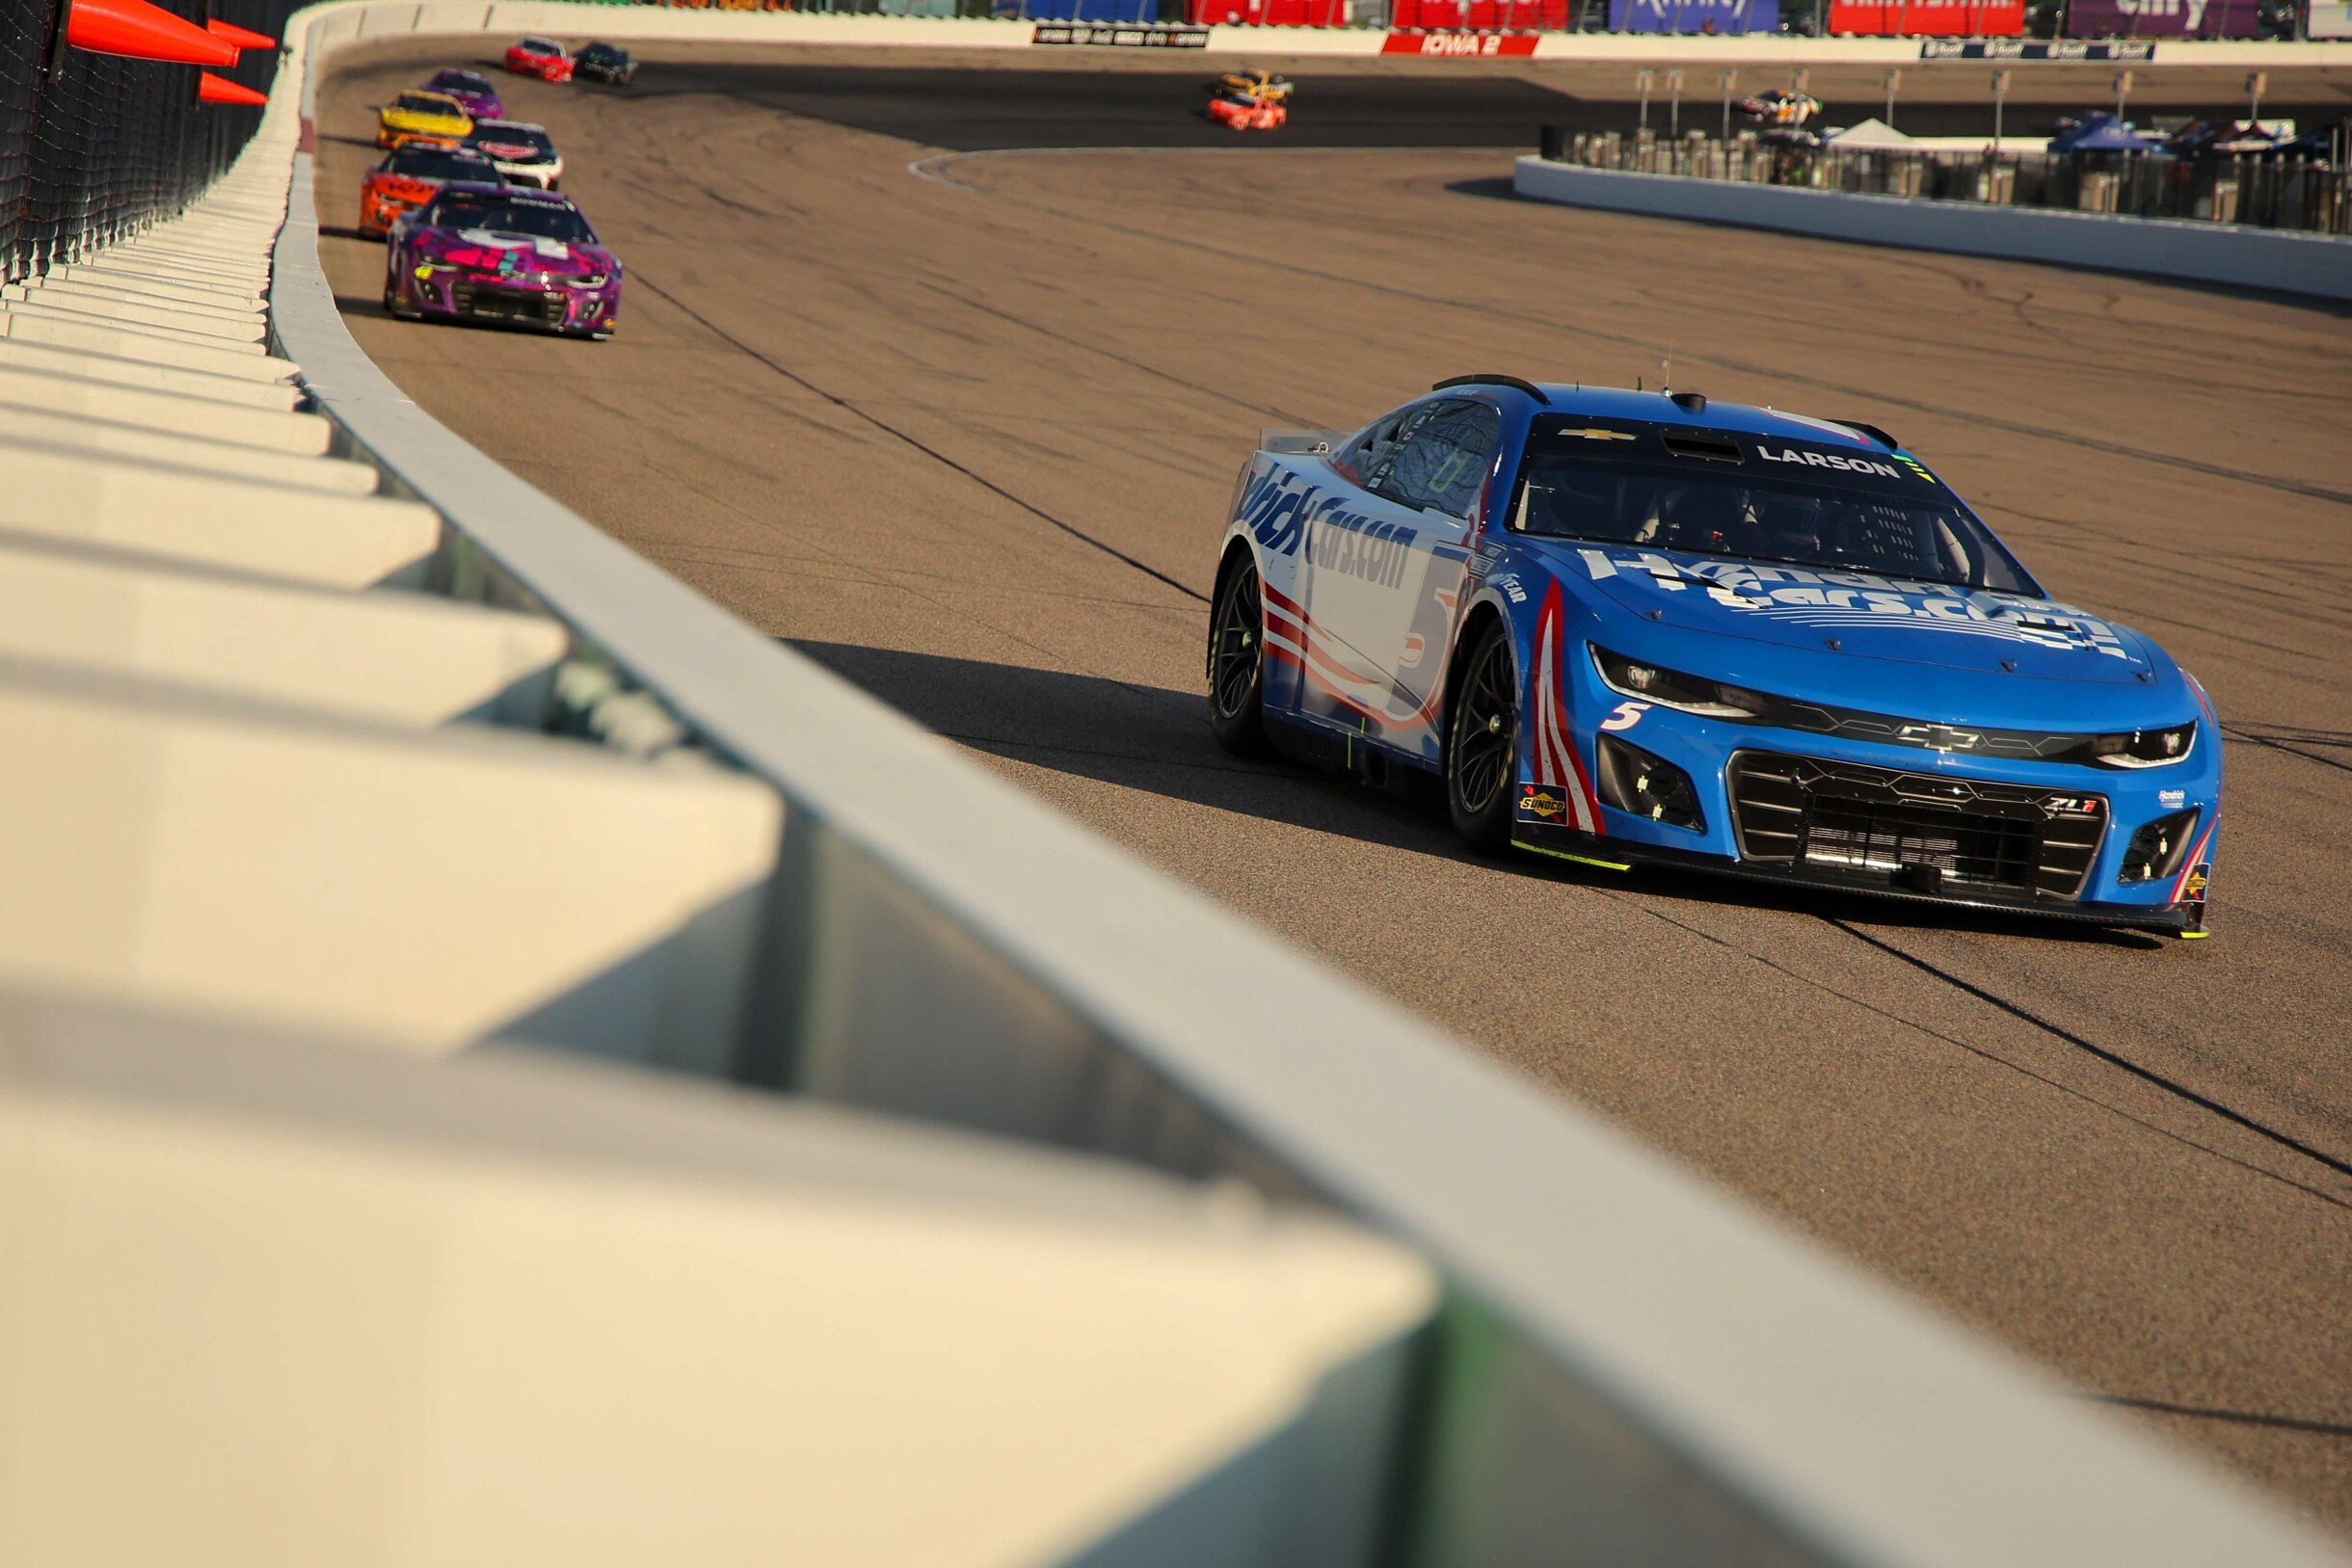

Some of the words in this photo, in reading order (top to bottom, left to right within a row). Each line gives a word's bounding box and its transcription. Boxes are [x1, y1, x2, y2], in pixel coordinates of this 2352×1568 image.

[1420, 34, 1479, 56] IOWA
[1481, 34, 1503, 55] 2
[1757, 445, 1901, 479] LARSON
[1381, 545, 1472, 722] 5
[1600, 701, 1652, 731] 5
[1520, 797, 1564, 811] SUNOCO
[2044, 797, 2098, 813] ZL1
